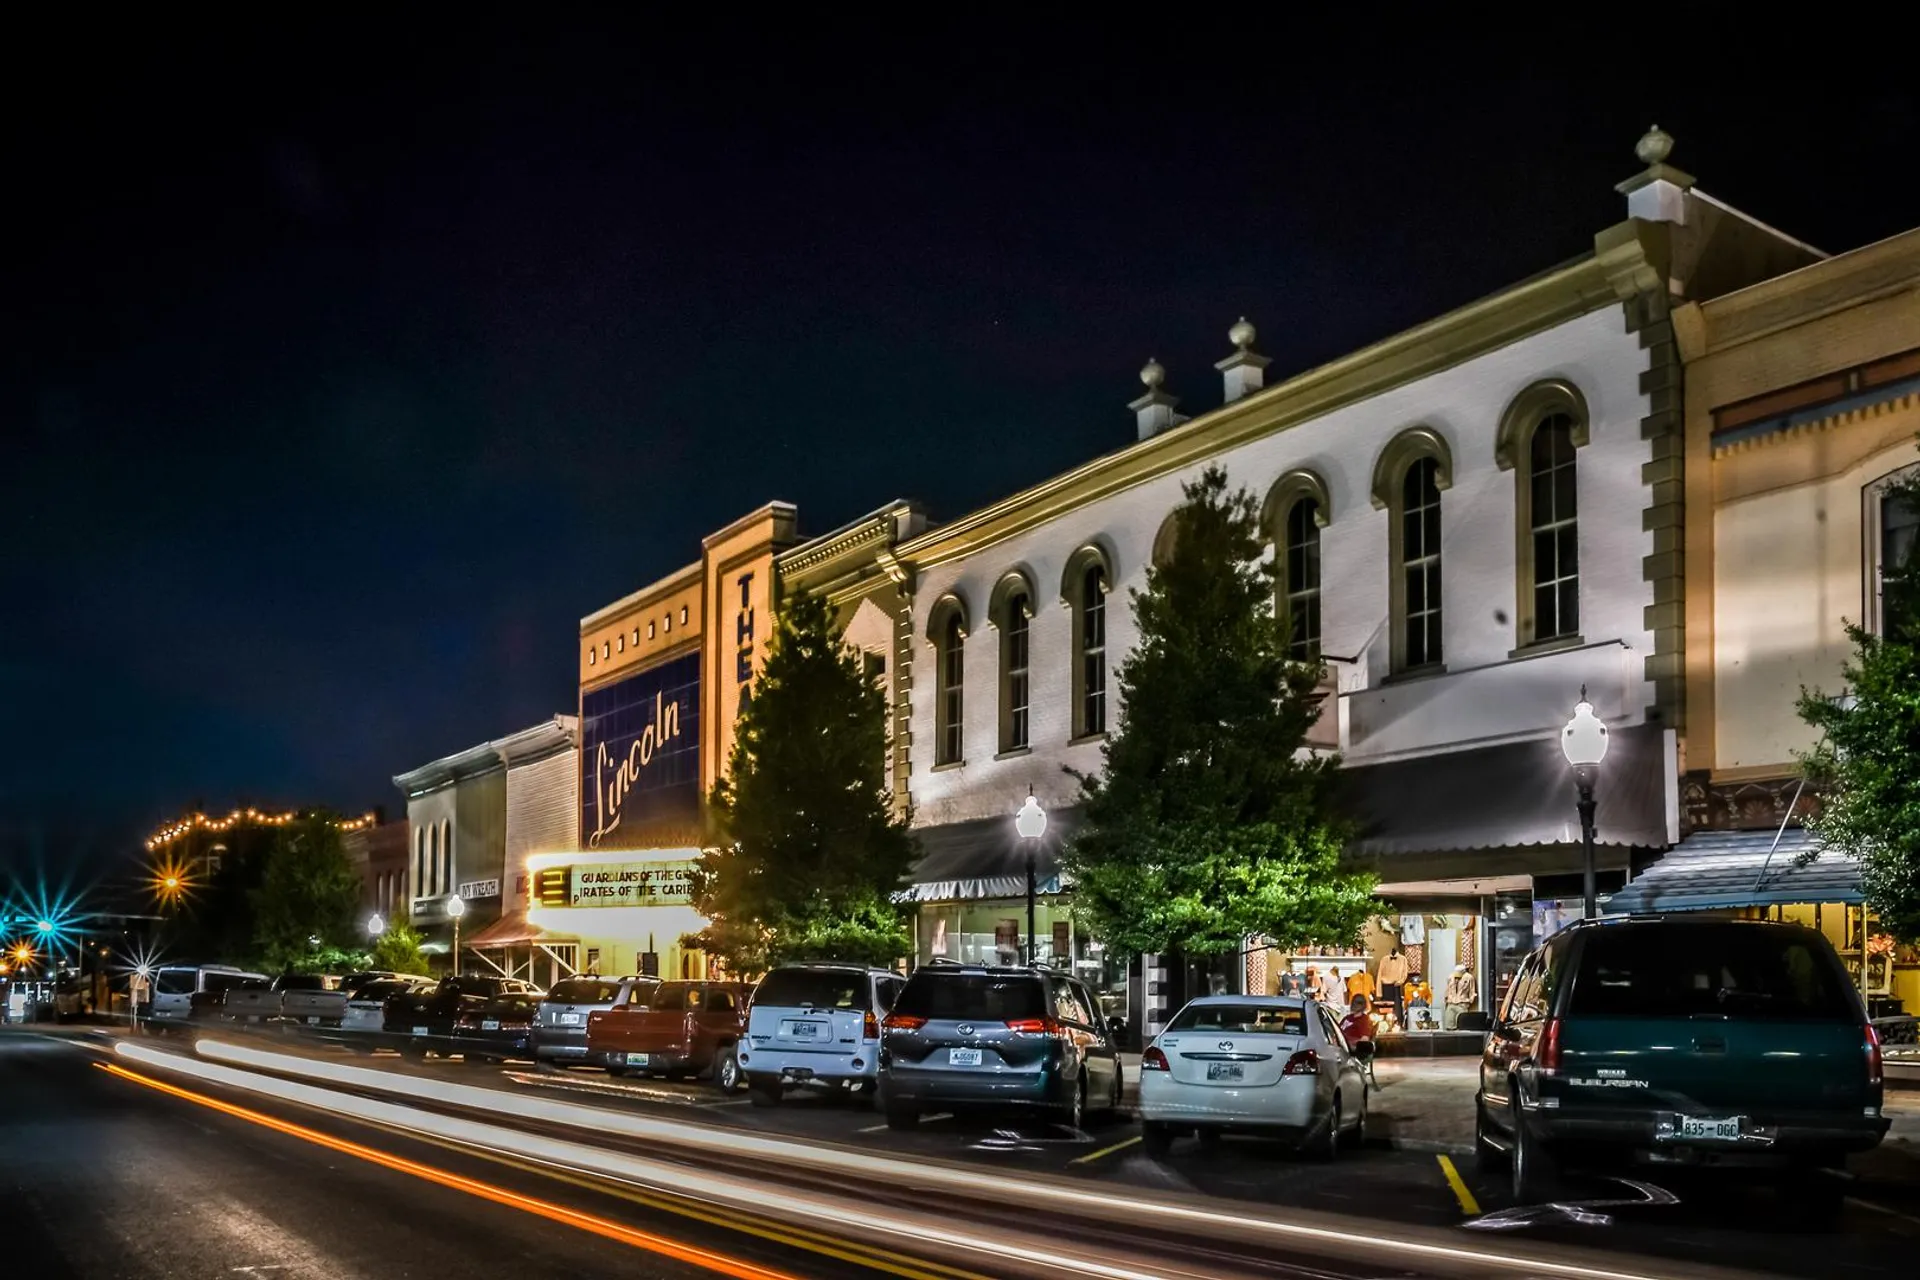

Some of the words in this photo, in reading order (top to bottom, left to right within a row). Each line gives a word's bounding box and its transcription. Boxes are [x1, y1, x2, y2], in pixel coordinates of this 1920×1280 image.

[590, 690, 680, 849] Lincoln
[581, 871, 640, 883] GUARDIANS
[641, 870, 652, 881] OF
[655, 870, 674, 881] THE
[472, 880, 496, 897] WREATH
[573, 886, 614, 905] PIRATES
[619, 885, 631, 896] OF
[1569, 1078, 1649, 1088] SUBURBAN
